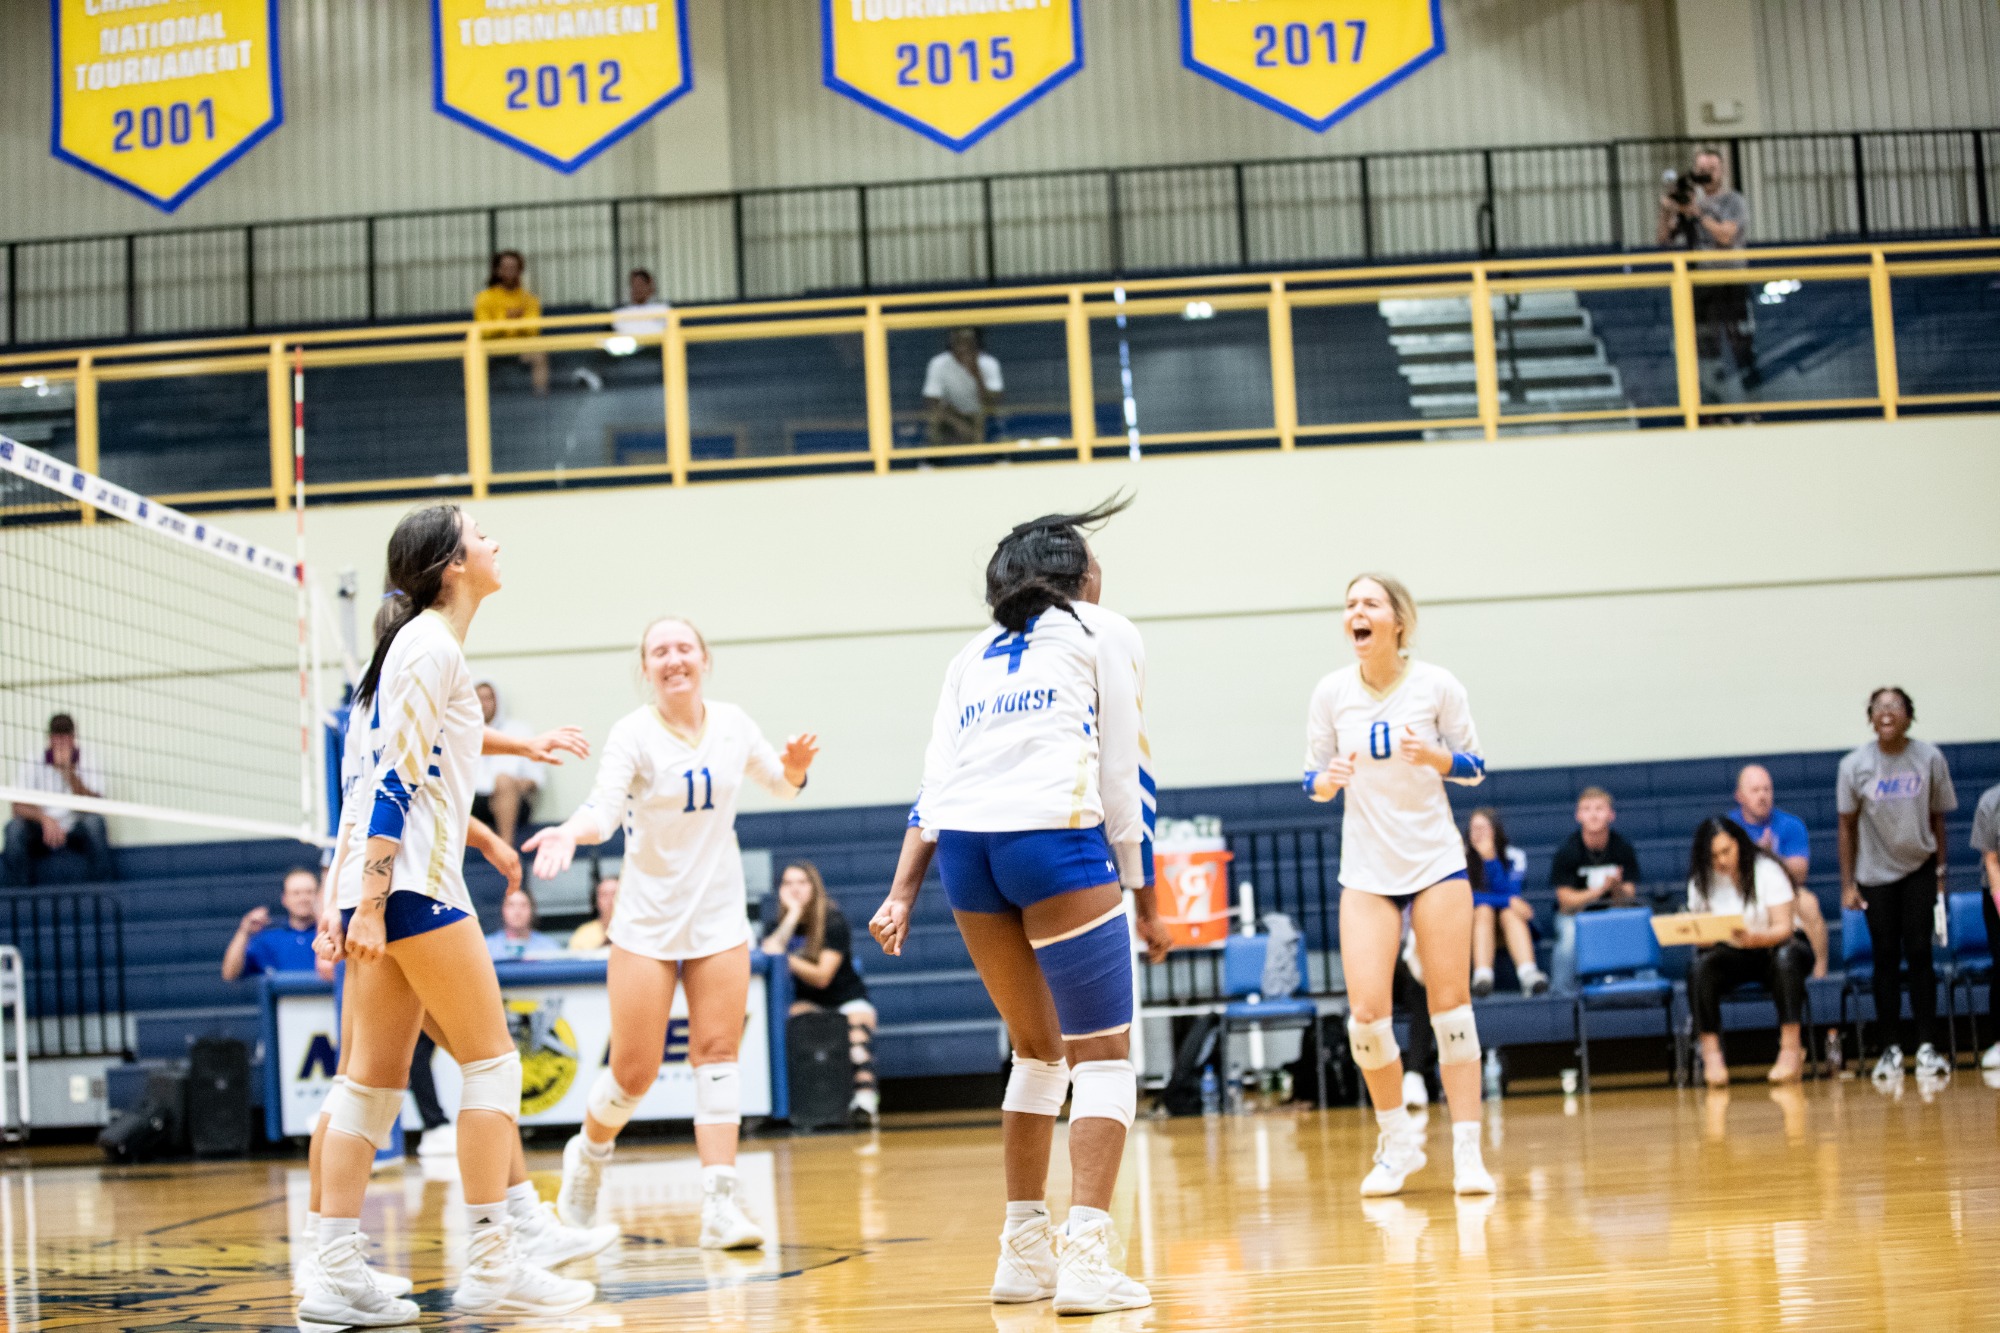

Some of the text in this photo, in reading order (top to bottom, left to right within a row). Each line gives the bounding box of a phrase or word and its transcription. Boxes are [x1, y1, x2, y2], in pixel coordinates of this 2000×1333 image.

[100, 12, 226, 55] NATIONAL
[458, 3, 658, 46] TOURNAMENT
[851, 0, 1051, 22] TOURNAM
[74, 40, 252, 91] TOURNAMENT
[896, 36, 1015, 87] 2015
[1253, 19, 1368, 68] 2017
[505, 59, 623, 110] 2012
[112, 97, 215, 153] 2001
[983, 616, 1039, 675] 4
[1370, 721, 1392, 760] 0
[683, 767, 715, 813] 11
